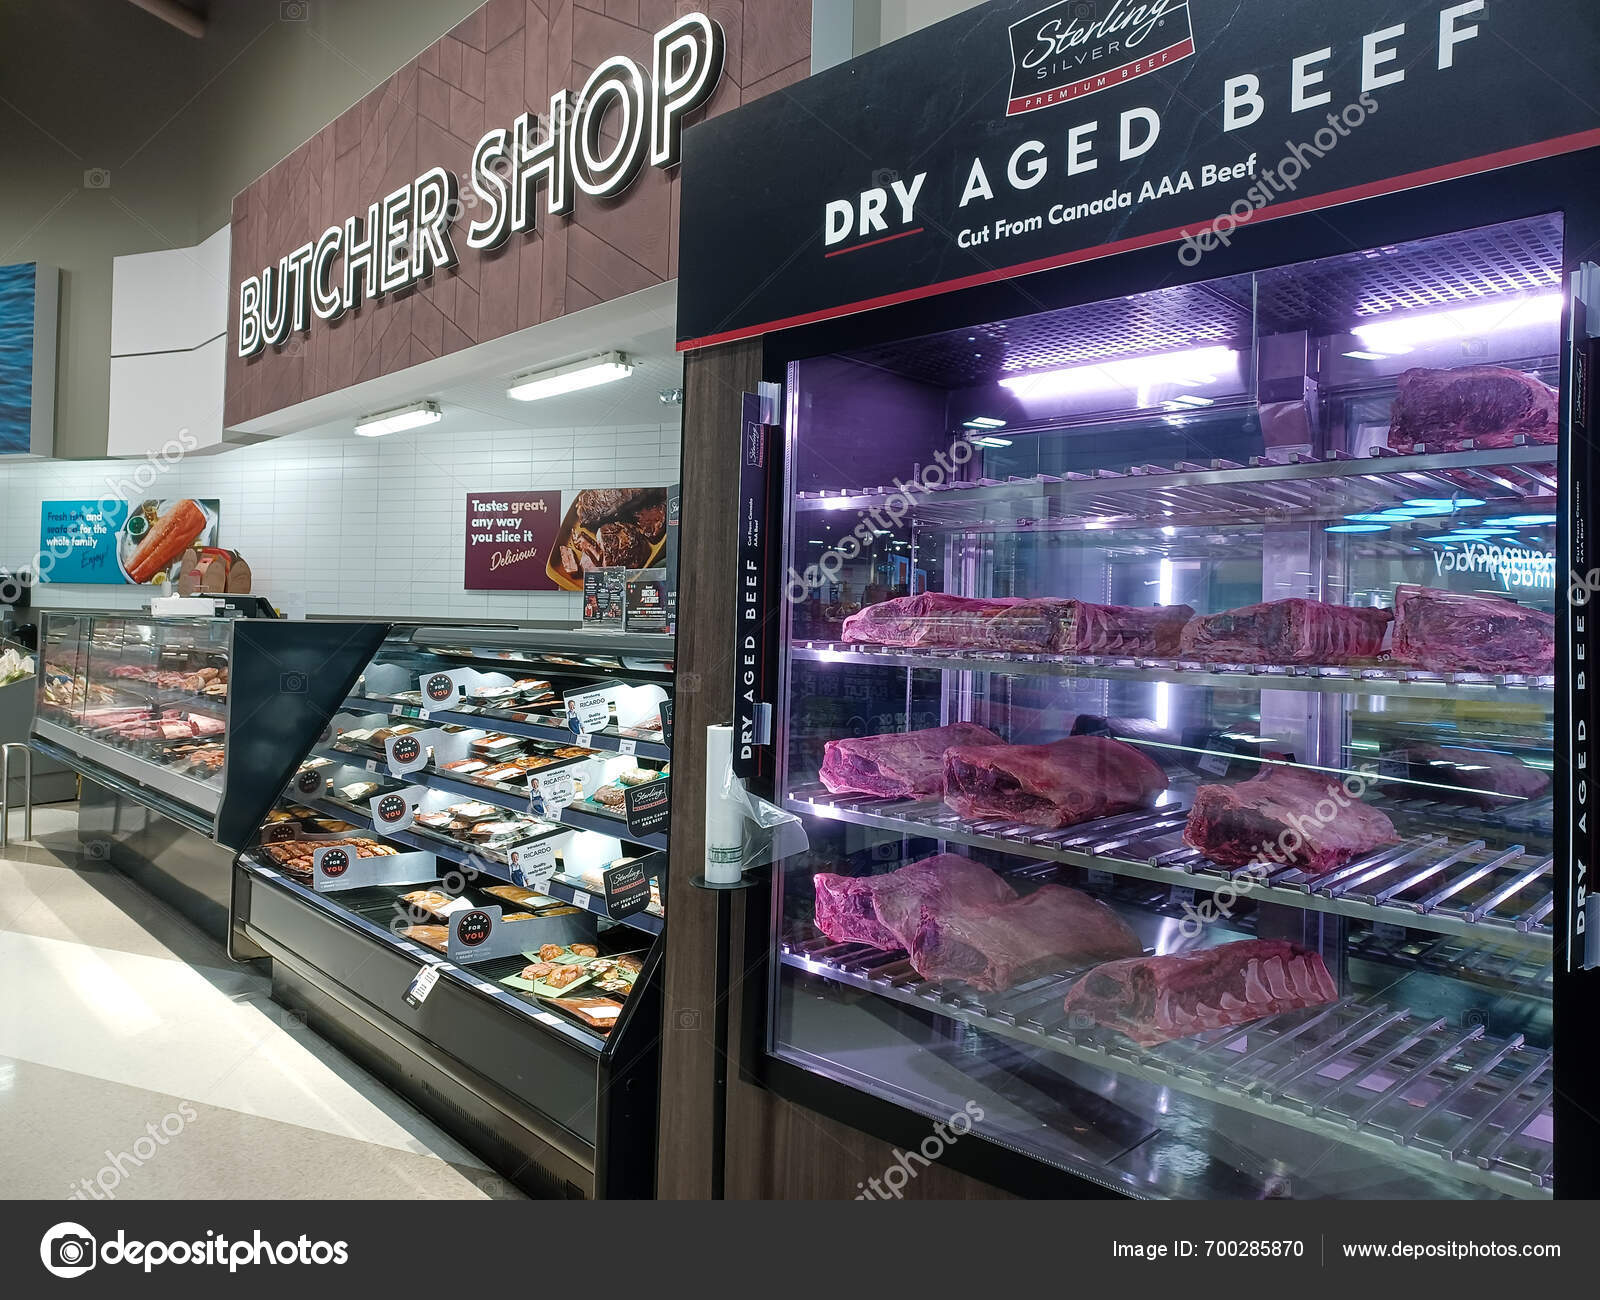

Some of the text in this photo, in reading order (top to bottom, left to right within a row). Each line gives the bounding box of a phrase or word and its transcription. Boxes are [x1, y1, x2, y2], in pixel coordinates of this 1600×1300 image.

[1022, 0, 1170, 68] Sterling
[1037, 41, 1119, 79] SILVER
[1025, 53, 1168, 108] PREMIUM BEEF
[824, 0, 1486, 246] DRY AGED BEEF
[238, 12, 718, 358] BUTCHER SHOP
[957, 153, 1257, 248] Cut From Canada AAA Beef
[472, 499, 548, 514] Tastes great,
[86, 511, 103, 521] and
[80, 524, 92, 534] for
[94, 524, 107, 534] the
[471, 518, 522, 530] any way
[47, 536, 98, 549] whole family
[471, 530, 533, 546] you slice it
[490, 547, 537, 571] Delicious
[741, 560, 757, 760] DRY AGED BEEF
[579, 697, 606, 707] RICARDO
[400, 751, 415, 759] YOU
[1576, 587, 1587, 936] DRY AGED BEEF
[543, 774, 571, 786] RICARDO
[385, 810, 401, 819] YOU
[523, 846, 552, 860] RICARDO
[327, 865, 343, 873] YOU
[464, 931, 484, 941] YOU
